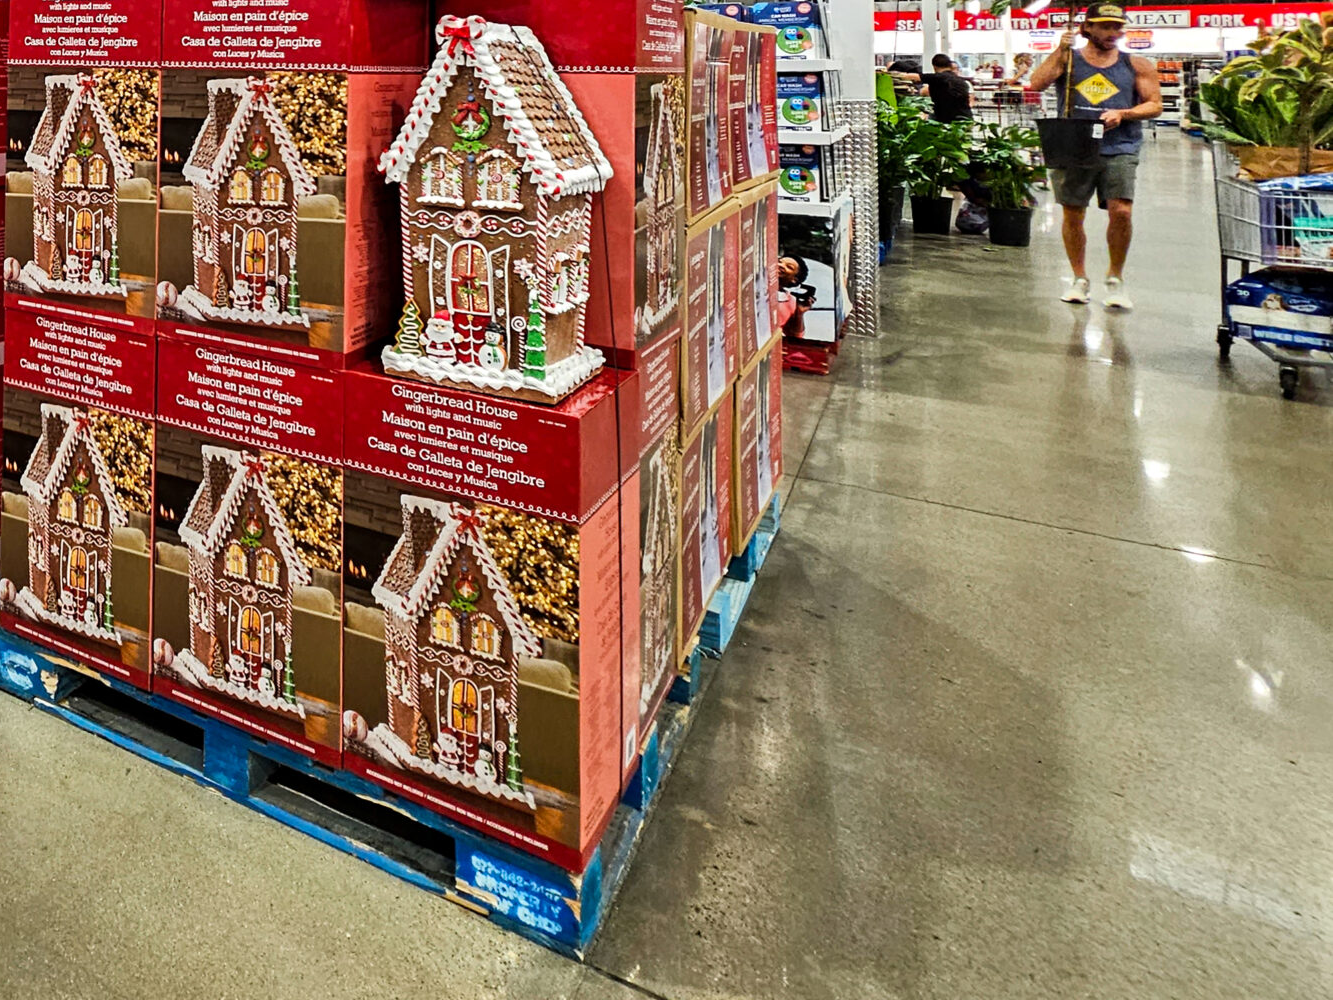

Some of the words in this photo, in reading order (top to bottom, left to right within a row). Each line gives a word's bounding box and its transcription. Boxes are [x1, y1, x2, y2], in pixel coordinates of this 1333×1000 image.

[34, 14, 62, 24] Maison
[76, 14, 93, 25] pain
[96, 13, 127, 25] d'épice
[194, 11, 228, 21] Maison
[230, 13, 243, 21] en
[244, 11, 266, 23] pain
[269, 11, 309, 22] d'épice
[897, 20, 959, 31] SEAD
[976, 18, 1038, 30] POUTRY
[1125, 14, 1182, 24] MEAT
[1198, 14, 1246, 27] PORK
[24, 36, 44, 46] Casa
[46, 37, 56, 46] de
[58, 37, 86, 46] Galleta
[88, 37, 99, 46] de
[100, 37, 138, 48] Jengibre
[181, 37, 205, 46] Casa
[207, 36, 220, 46] de
[222, 36, 257, 47] Galleta
[259, 38, 273, 47] de
[275, 36, 321, 49] Jengibre
[36, 316, 87, 336] Gingerbread
[89, 328, 116, 342] House
[30, 338, 58, 352] Maison
[59, 346, 73, 355] en
[71, 348, 88, 360] pain
[90, 351, 122, 368] d'épice
[195, 348, 260, 370] Gingerbread
[262, 360, 295, 377] House
[20, 358, 39, 372] Casa
[41, 364, 51, 374] de
[52, 366, 81, 382] Galleta
[82, 373, 94, 384] de
[95, 376, 132, 394] Jengibre
[188, 371, 222, 388] Maison
[224, 382, 237, 391] en
[238, 383, 260, 397] pain
[263, 388, 303, 406] d'épice
[176, 394, 200, 409] Casa
[202, 400, 214, 412] de
[216, 403, 251, 421] Galleta
[253, 412, 267, 425] de
[268, 416, 316, 436] Jengibre
[391, 385, 473, 412] Gingerbread
[475, 401, 518, 420] House
[405, 402, 424, 415] with
[426, 406, 450, 420] lights
[453, 413, 471, 423] and
[473, 417, 502, 430] music
[382, 410, 425, 432] Maison
[429, 423, 444, 435] en
[447, 426, 474, 443] pain
[478, 432, 528, 453] d'épice
[394, 430, 415, 441] avec
[418, 434, 458, 451] lumieres
[460, 444, 469, 453] et
[471, 447, 513, 463] musique
[368, 437, 397, 454] Casa
[400, 445, 416, 458] de
[419, 448, 463, 469] Galleta
[466, 460, 483, 474] de
[486, 464, 545, 489] Jengibre
[407, 462, 423, 472] con
[426, 464, 453, 480] Luces
[455, 473, 461, 483] y
[463, 474, 498, 491] Musica
